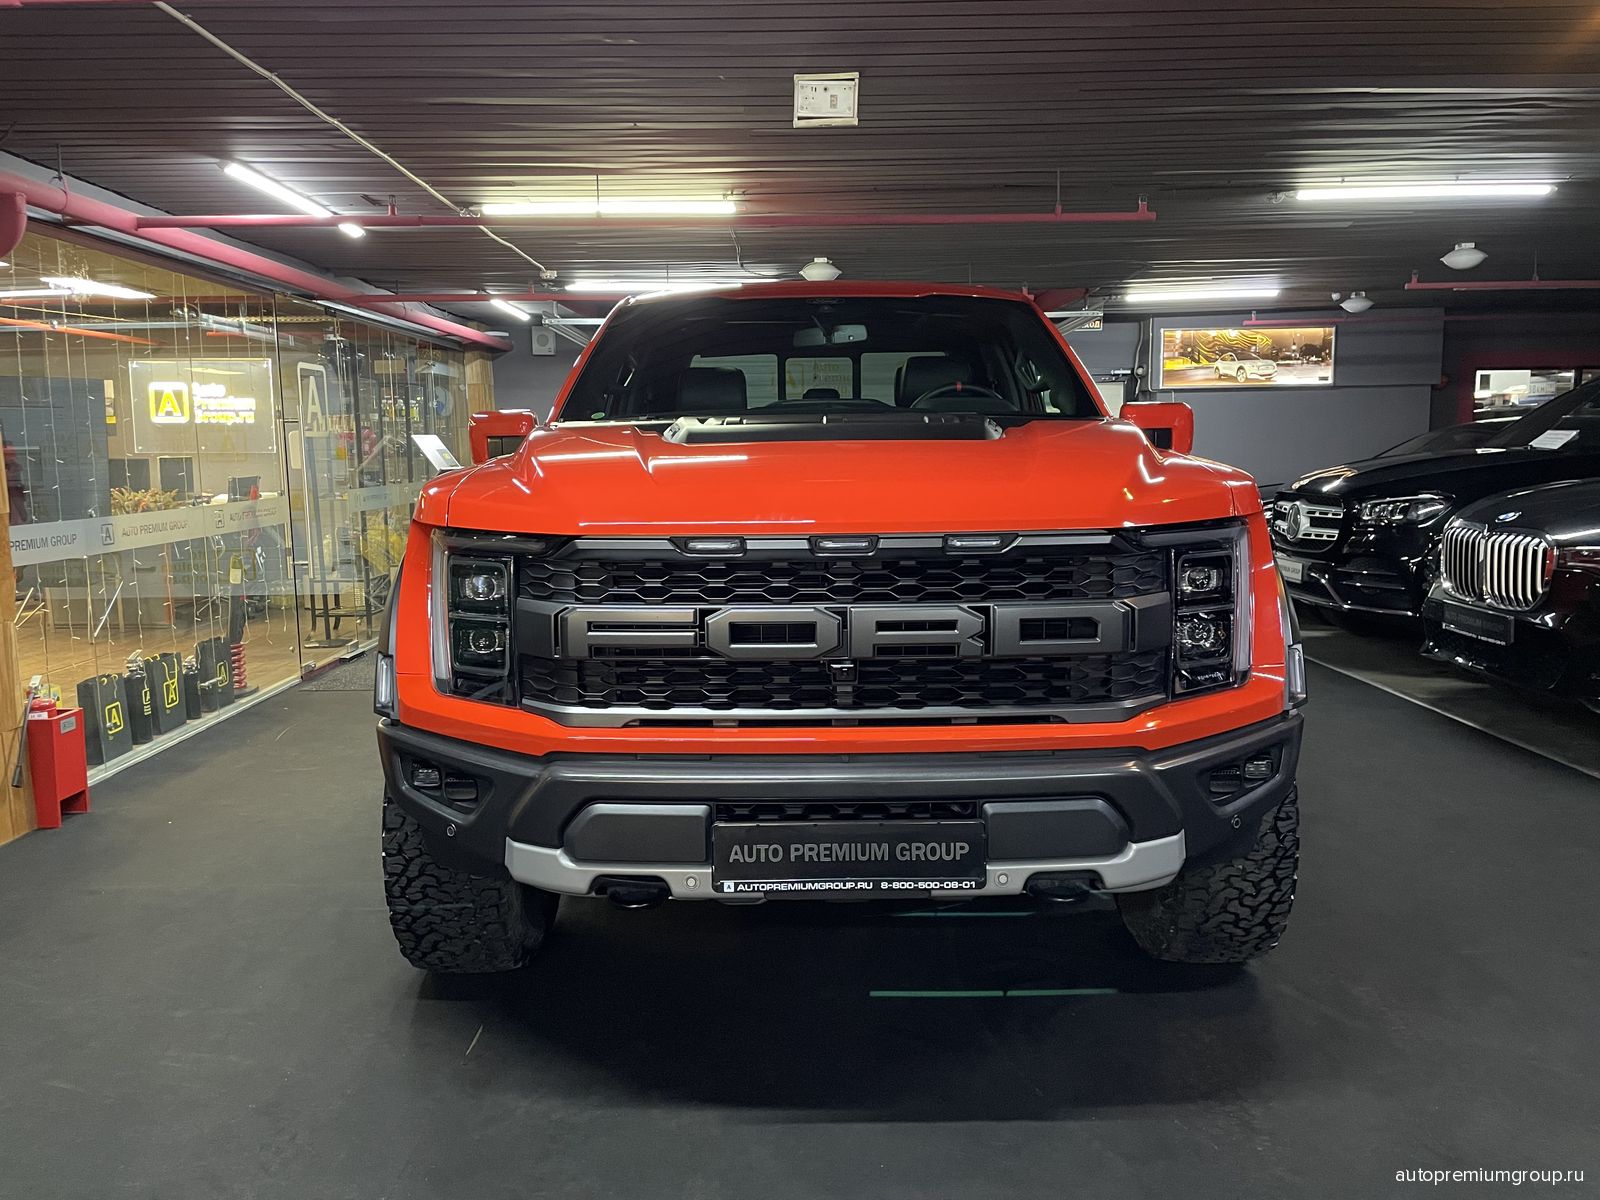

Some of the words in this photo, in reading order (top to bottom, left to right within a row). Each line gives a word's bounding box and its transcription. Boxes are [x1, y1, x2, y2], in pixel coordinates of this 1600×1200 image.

[122, 525, 139, 537] AUTO
[140, 522, 168, 534] PREMIUM
[10, 538, 49, 552] PREMIUM
[50, 533, 78, 547] GROUP
[562, 603, 1130, 660] FORD
[728, 844, 784, 863] AUTO
[789, 842, 889, 862] PREMIUM
[895, 841, 970, 861] GROUP
[736, 881, 873, 892] AUTOPREMIUMGROUP.RU
[880, 880, 976, 890] 8-800-500-08-01
